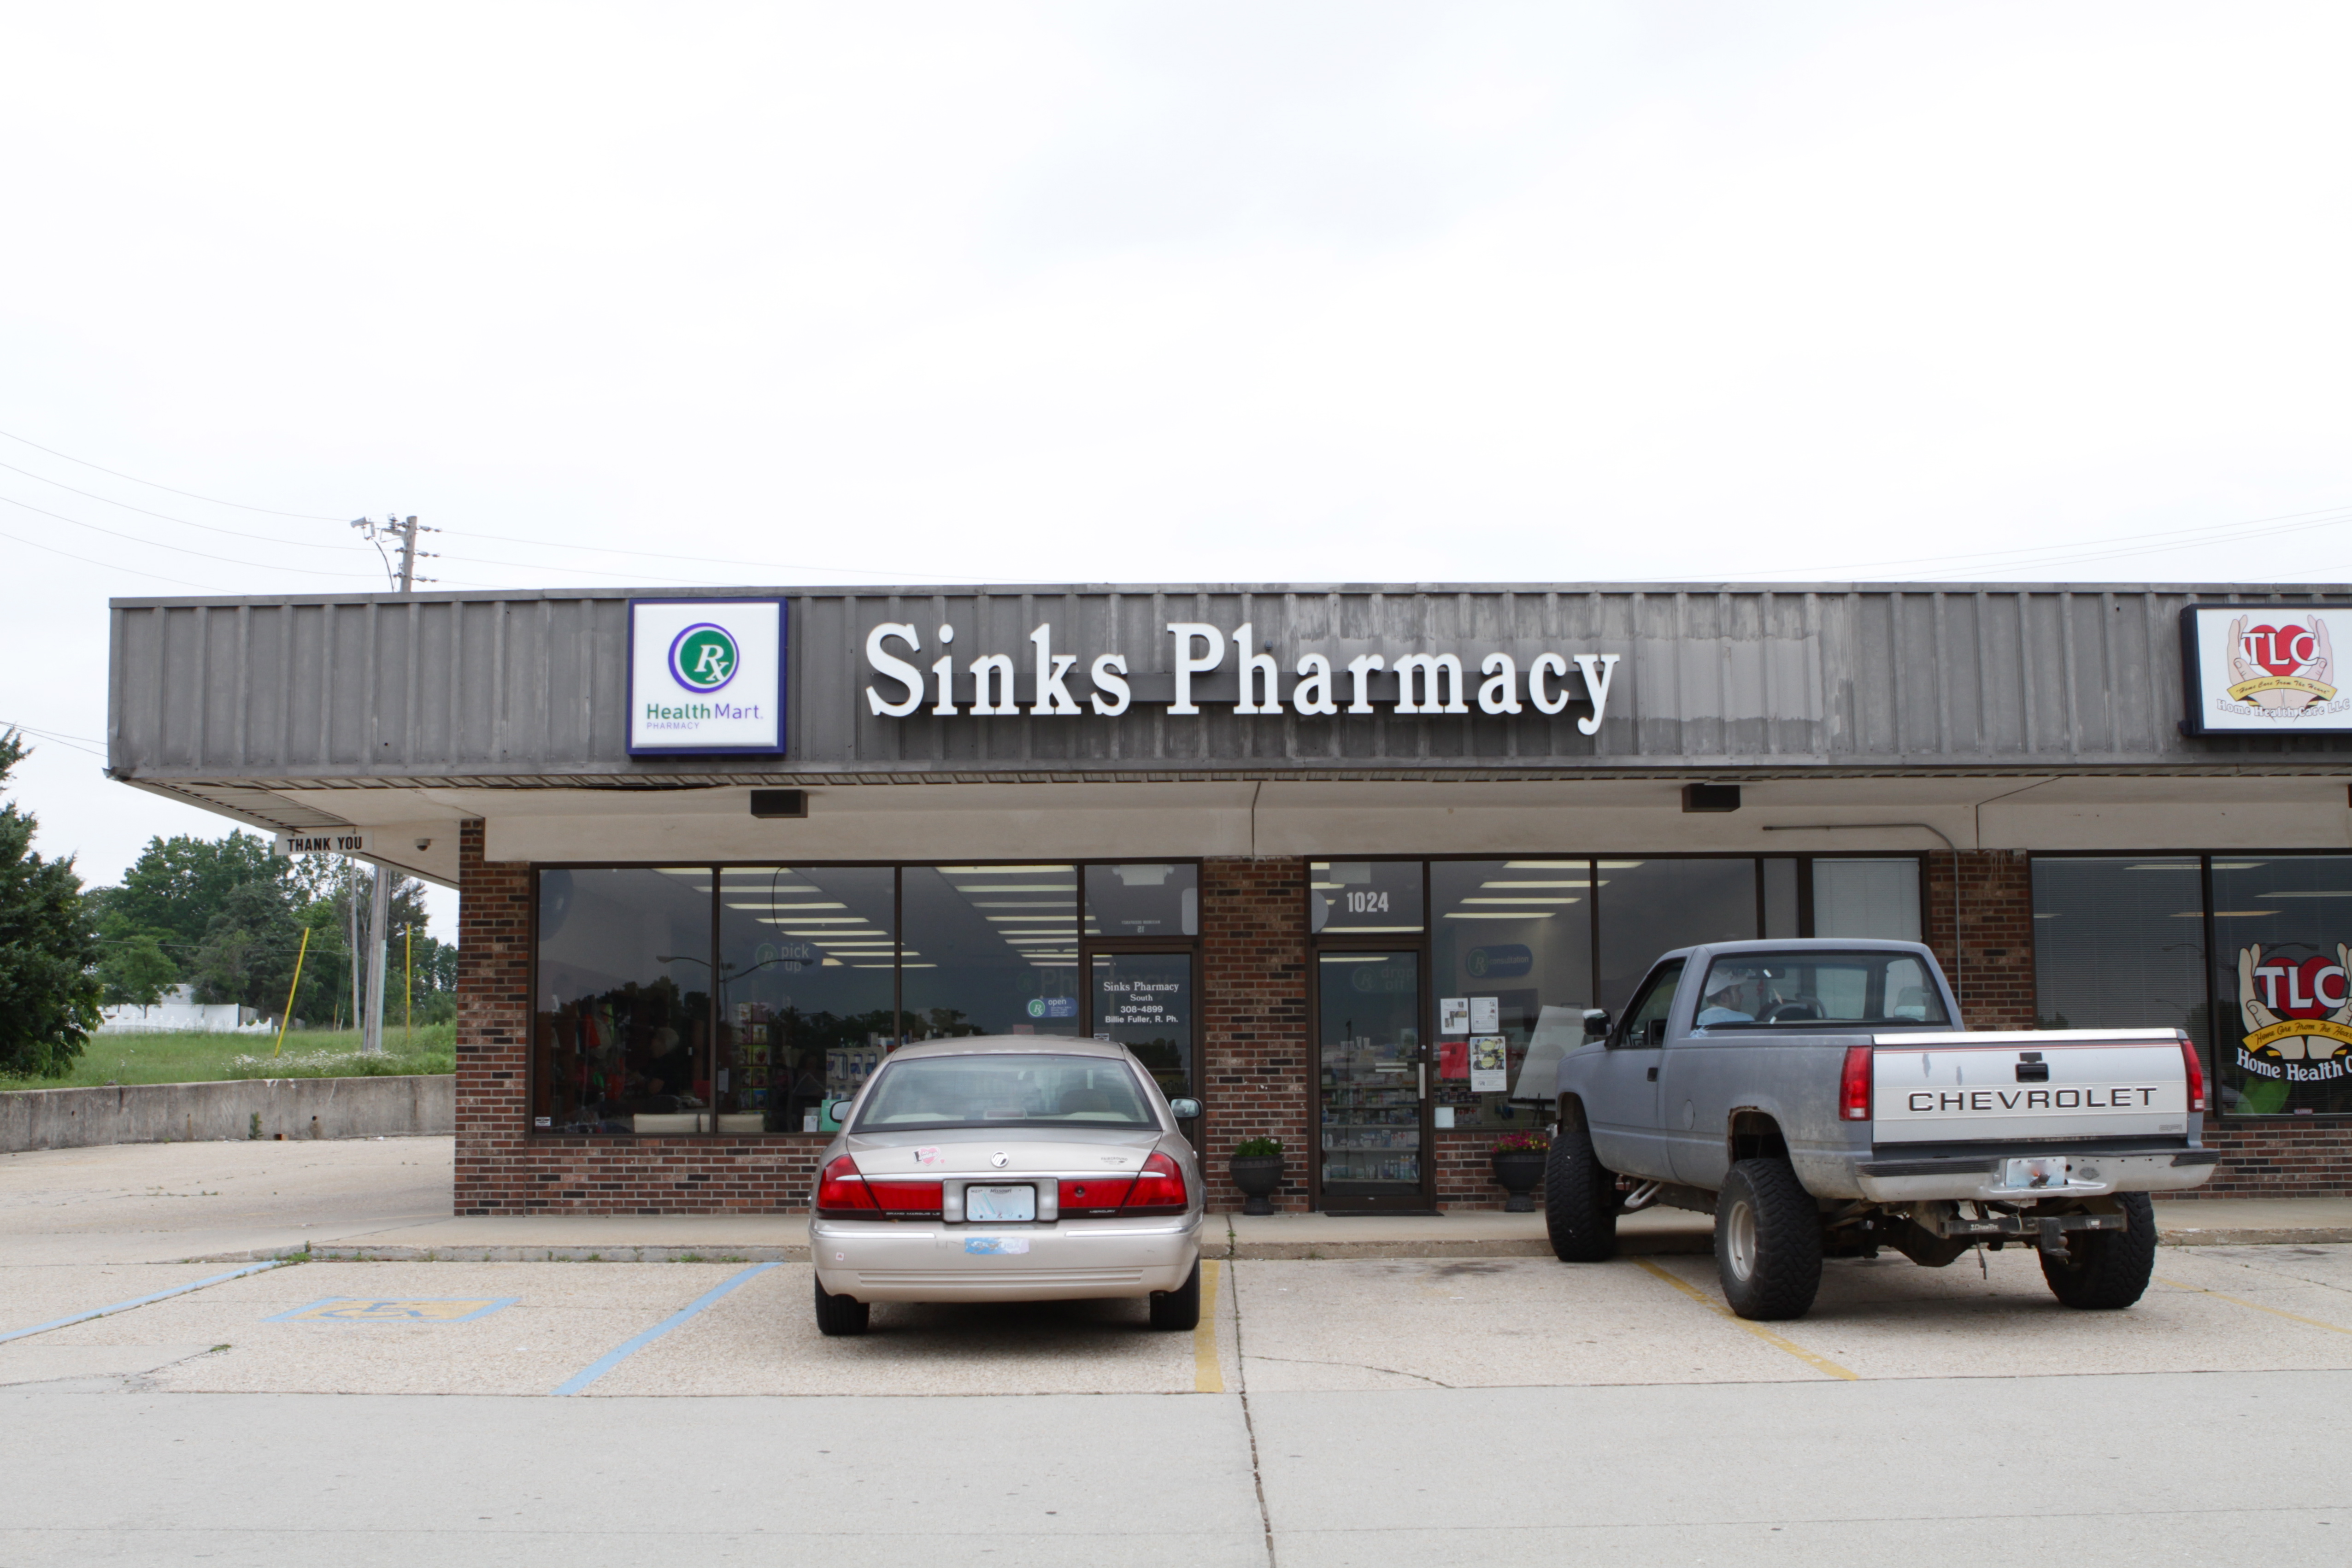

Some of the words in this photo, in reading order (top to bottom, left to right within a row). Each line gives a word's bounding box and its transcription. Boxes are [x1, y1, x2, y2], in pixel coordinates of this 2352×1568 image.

[2240, 632, 2319, 666] TLC
[866, 623, 1131, 716] Sinks
[1167, 623, 1620, 735] Pharmacy
[647, 703, 711, 719] Health
[2217, 699, 2251, 715] Home
[2254, 706, 2295, 717] Health
[2297, 705, 2325, 717] Care
[2328, 699, 2350, 714] LLC
[287, 837, 331, 852] THANK
[337, 836, 362, 850] YOU
[1347, 892, 1389, 913] 1024
[781, 943, 809, 960] pick
[785, 961, 802, 973] up
[1488, 956, 1529, 965] consultation
[1381, 965, 1415, 981] drop
[1104, 981, 1130, 991] Sinks
[1134, 981, 1179, 992] Pharmacy
[2253, 966, 2348, 1009] TLC
[1127, 1015, 1152, 1024] Fuller,
[2277, 1026, 2292, 1035] Care
[2294, 1022, 2315, 1033] From
[2319, 1023, 2331, 1033] The
[2236, 1047, 2281, 1079] Home
[2285, 1060, 2344, 1081] Health
[1908, 1086, 2158, 1112] CHEVROLET
